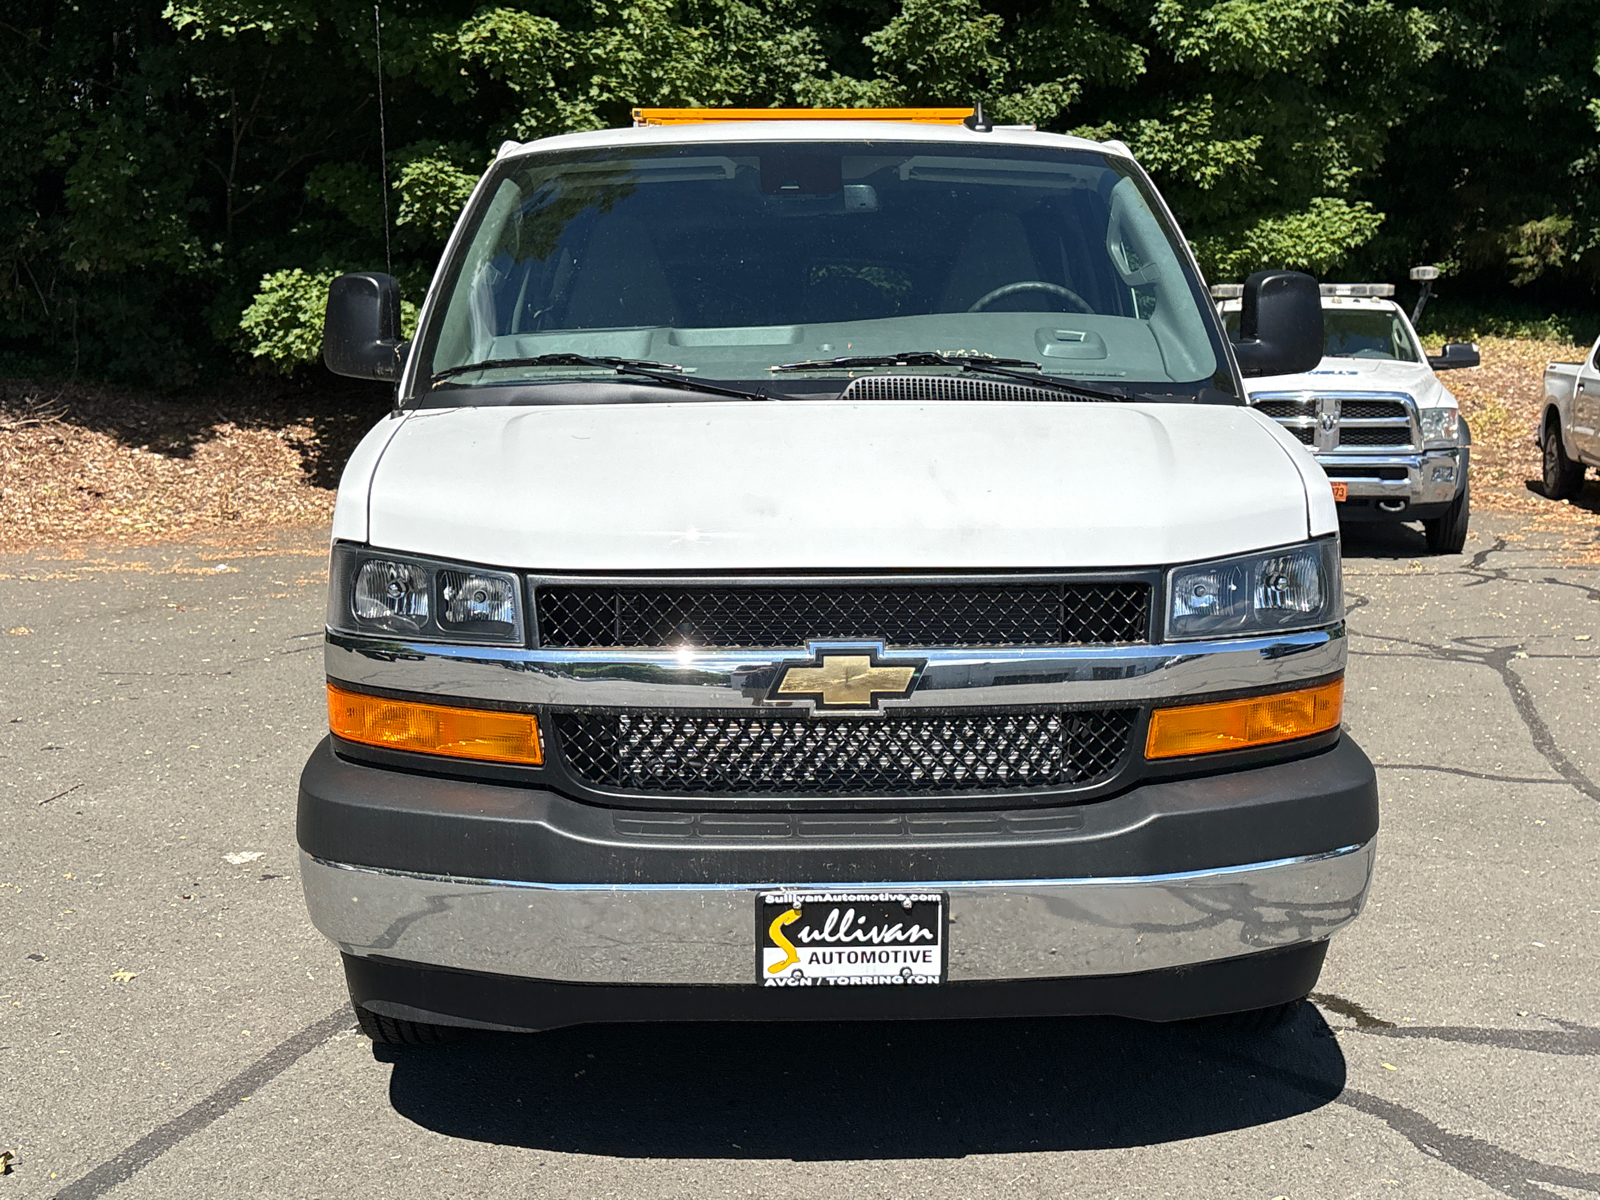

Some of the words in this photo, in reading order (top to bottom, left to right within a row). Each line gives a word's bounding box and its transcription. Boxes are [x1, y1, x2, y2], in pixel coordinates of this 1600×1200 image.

[765, 893, 942, 904] SullivanAutomotive.com
[767, 907, 934, 974] Sullivan
[808, 949, 933, 965] AUTOMOTIVE
[764, 977, 812, 987] AVON
